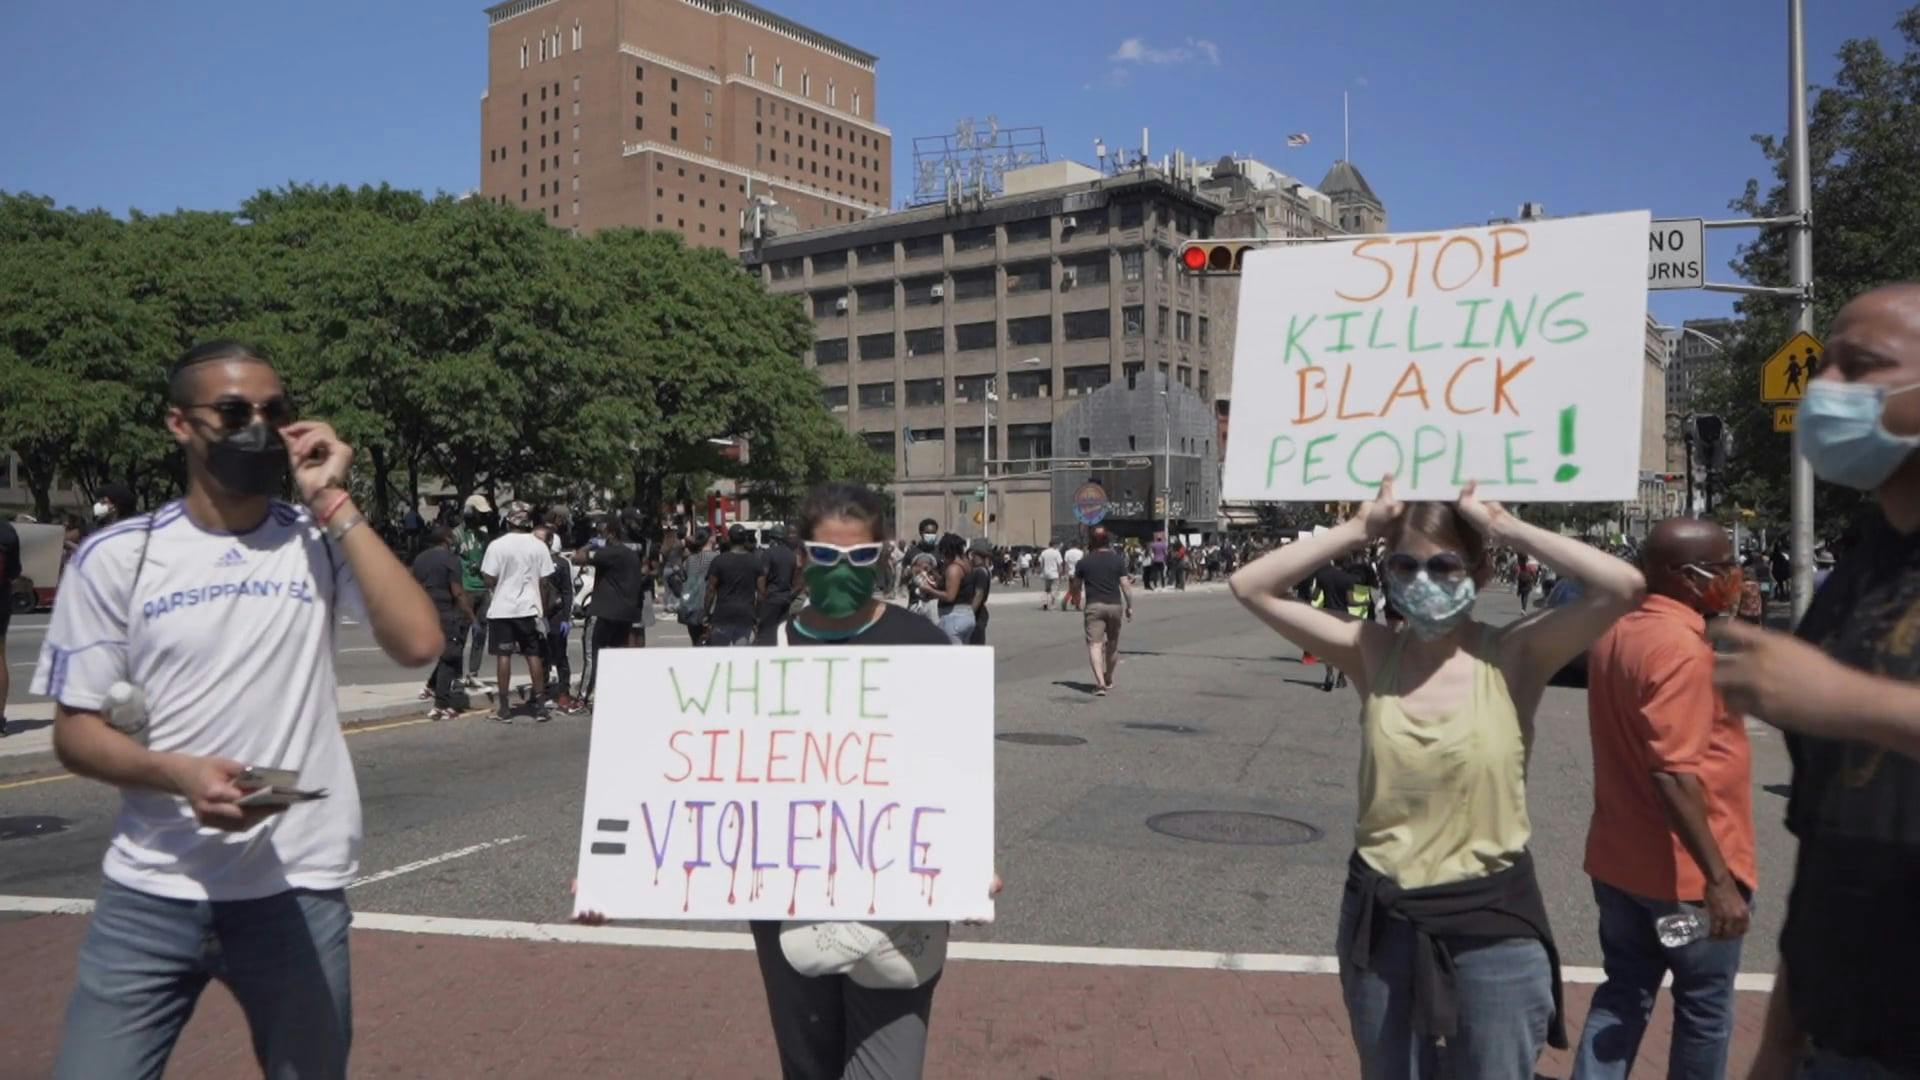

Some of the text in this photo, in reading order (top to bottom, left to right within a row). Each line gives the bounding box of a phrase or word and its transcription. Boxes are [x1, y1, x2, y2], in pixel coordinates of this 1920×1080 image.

[1335, 227, 1529, 301] STOP
[1648, 261, 1699, 280] URNS
[1649, 230, 1684, 251] NO
[1283, 292, 1589, 365] KILLING
[1291, 356, 1535, 425] BLACK
[1266, 403, 1580, 489] PEOPLE!
[143, 581, 282, 619] PARSIPPANY
[668, 657, 890, 719] WHITE
[663, 728, 894, 786] SILENCE
[640, 799, 946, 876] VIOLENCE
